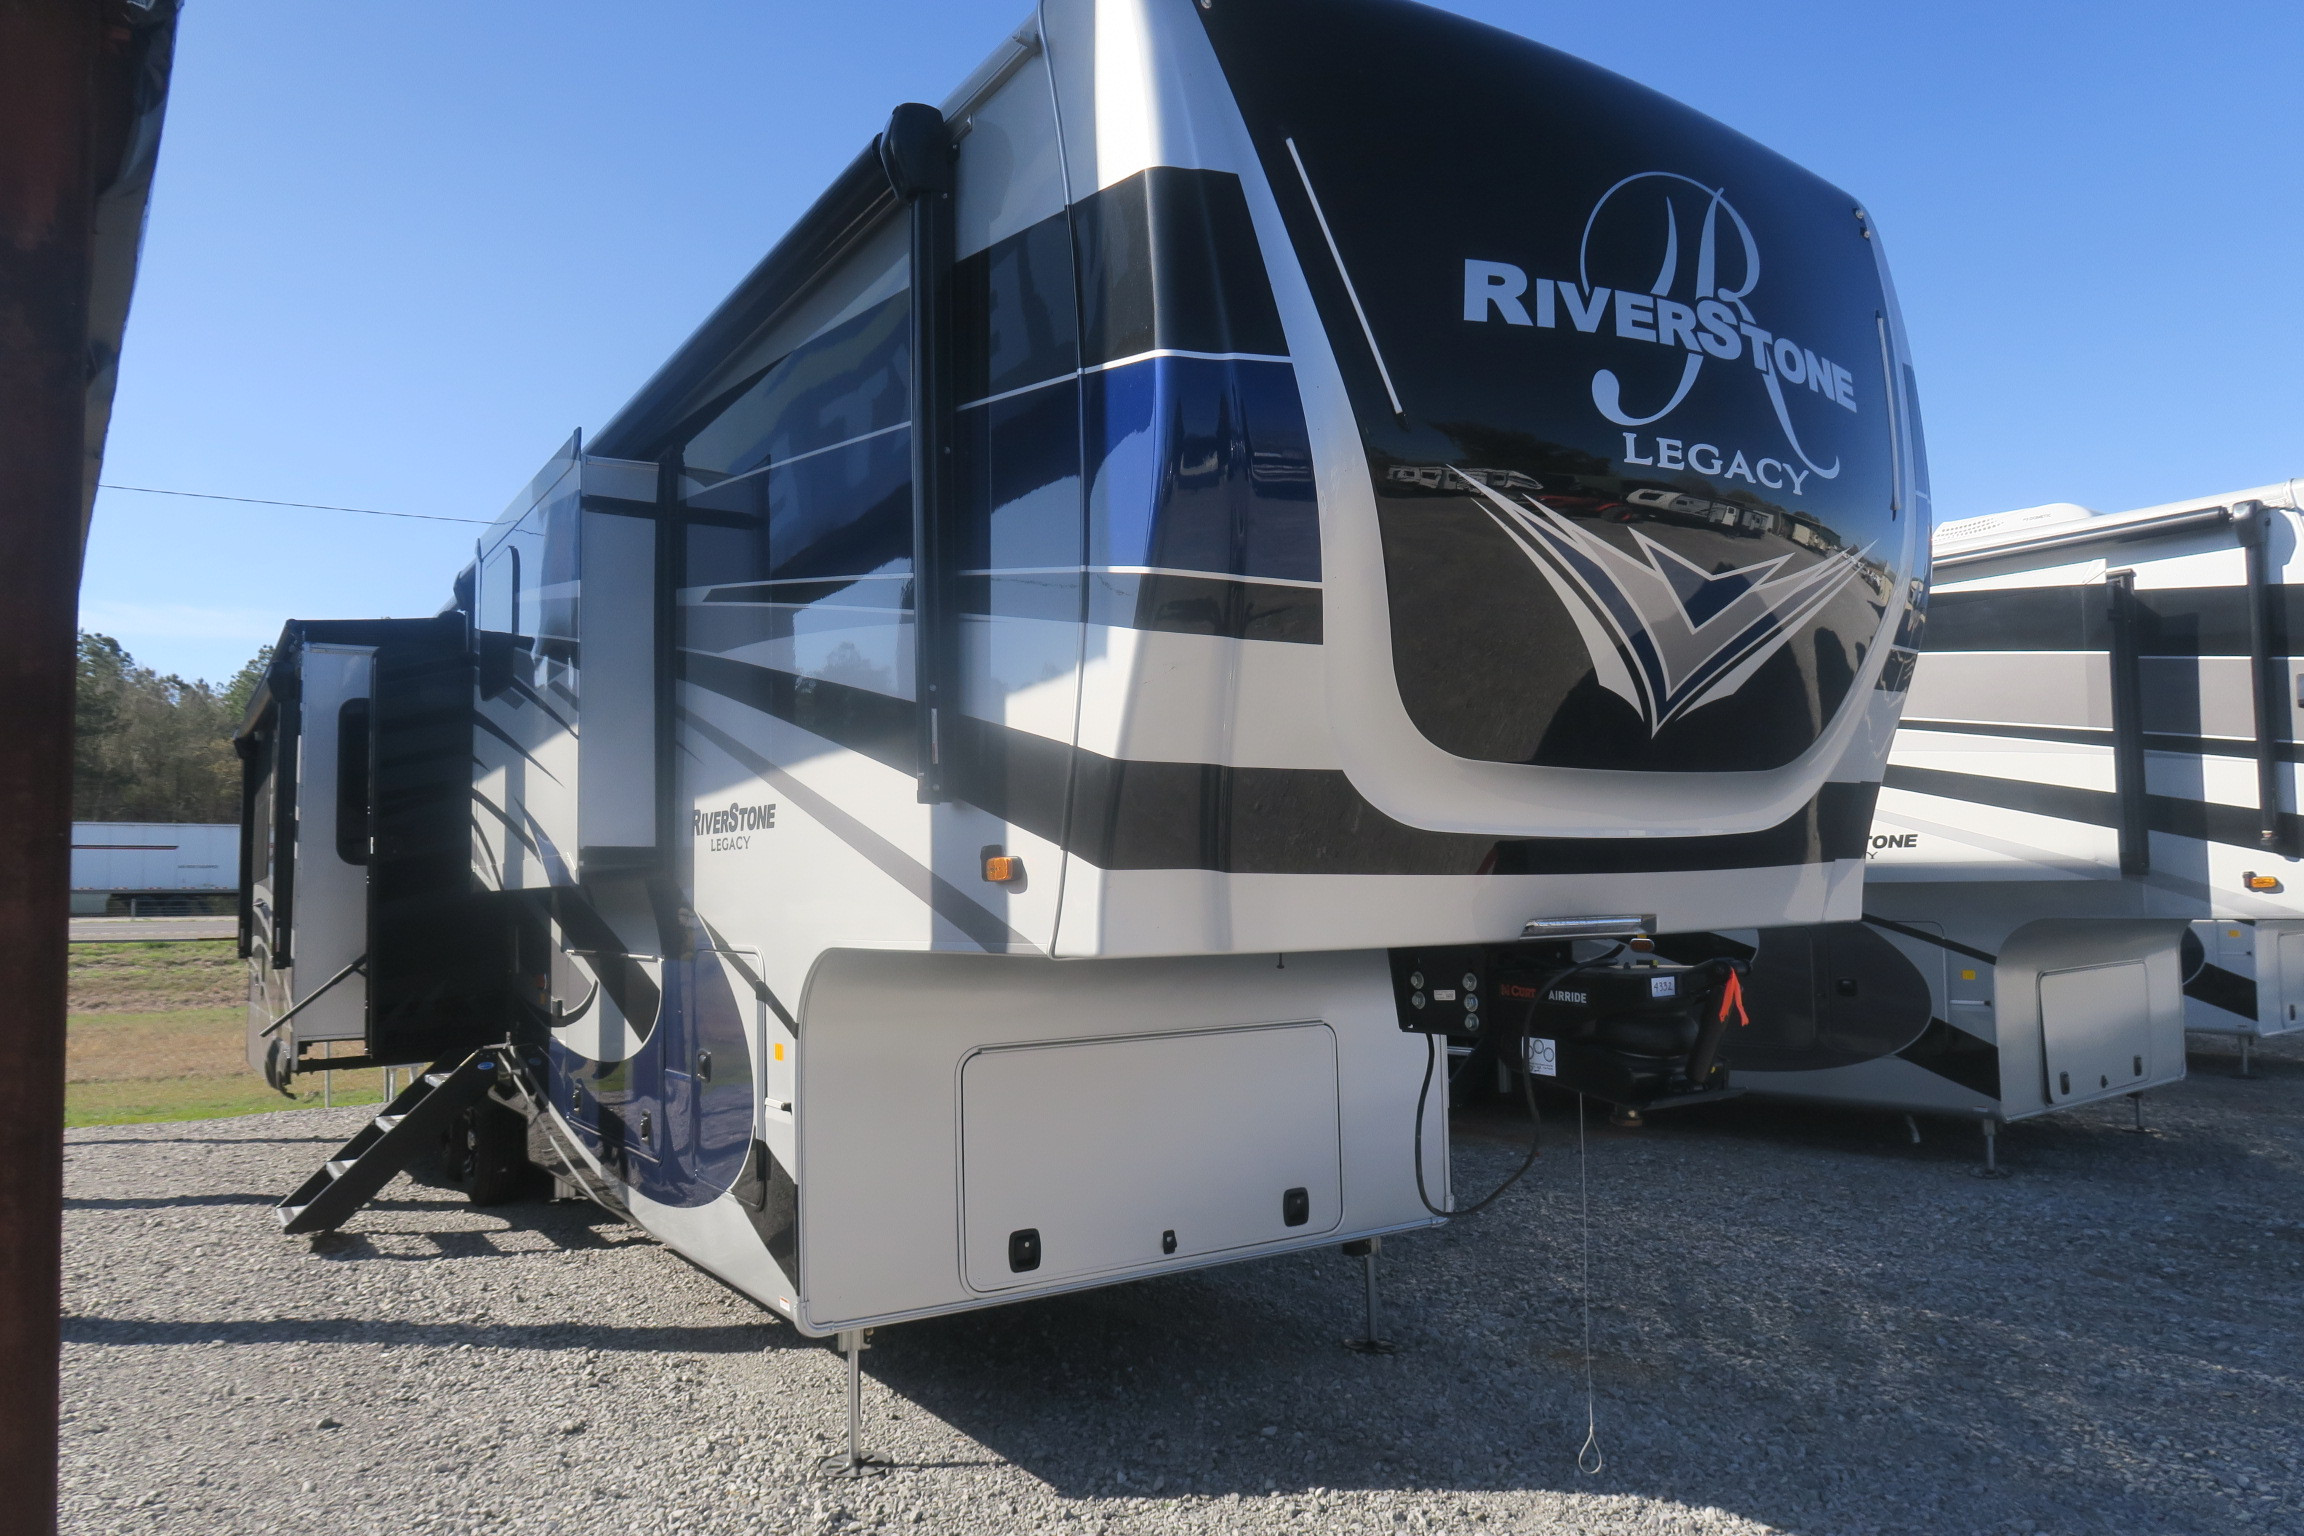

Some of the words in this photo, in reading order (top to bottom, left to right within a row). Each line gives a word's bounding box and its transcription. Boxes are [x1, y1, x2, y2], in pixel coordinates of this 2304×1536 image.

[1463, 258, 1857, 413] RIVERSTONE
[1622, 431, 1810, 496] LEGACY
[692, 802, 777, 836] RIVERSTONE
[710, 836, 751, 852] LEGACY
[1548, 989, 1588, 1004] AIRRIDE
